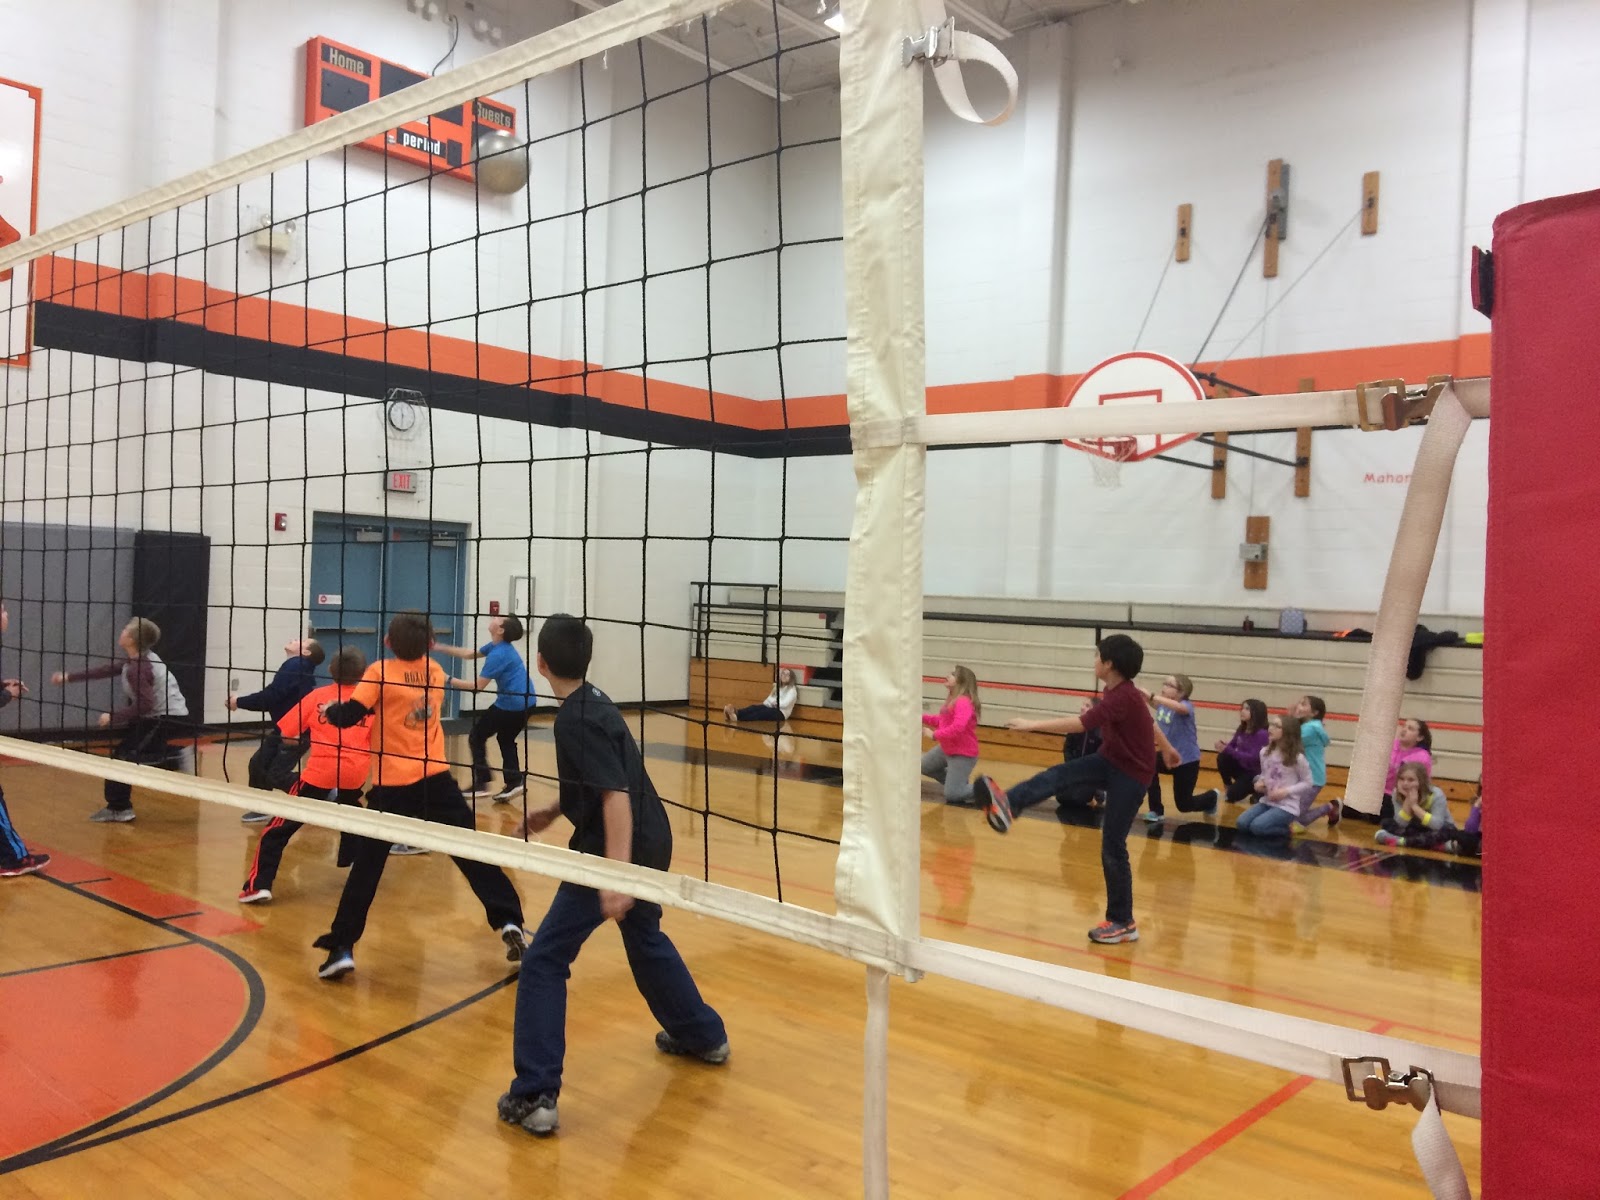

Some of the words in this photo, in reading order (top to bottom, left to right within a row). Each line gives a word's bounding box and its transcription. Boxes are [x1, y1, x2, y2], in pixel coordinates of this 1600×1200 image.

[330, 47, 364, 75] Home
[403, 132, 441, 156] period
[392, 472, 411, 489] EXIT
